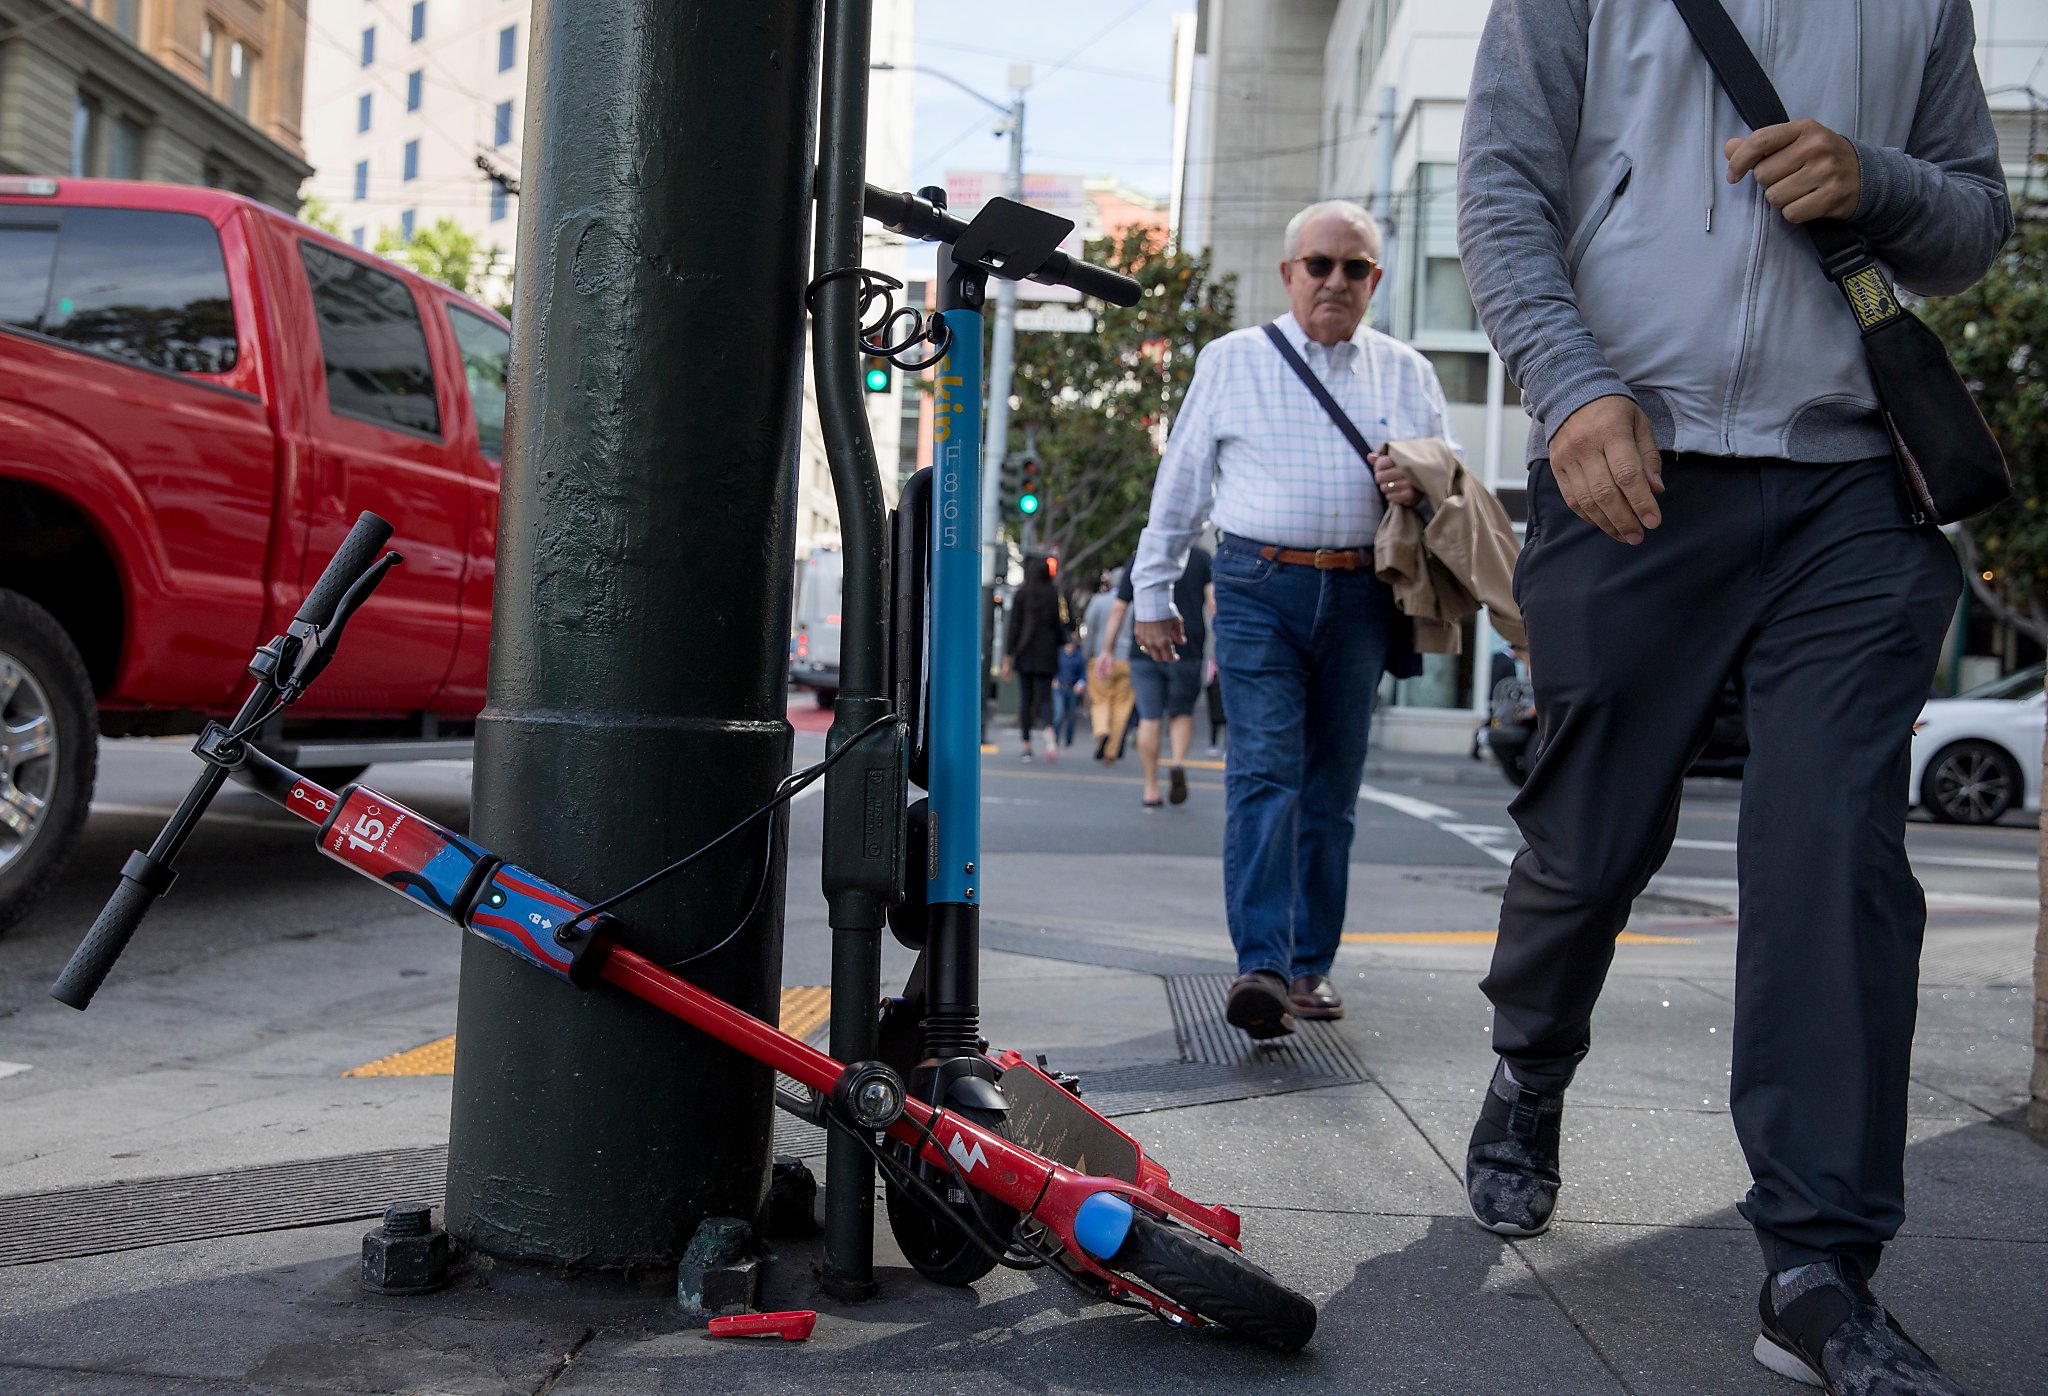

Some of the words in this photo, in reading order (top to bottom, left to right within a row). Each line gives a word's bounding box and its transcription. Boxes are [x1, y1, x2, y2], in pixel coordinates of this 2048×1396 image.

[1853, 280, 1876, 319] Benga
[943, 445, 960, 547] F865
[333, 836, 344, 851] ride
[340, 822, 351, 836] for
[378, 838, 389, 853] per
[386, 814, 406, 839] minute
